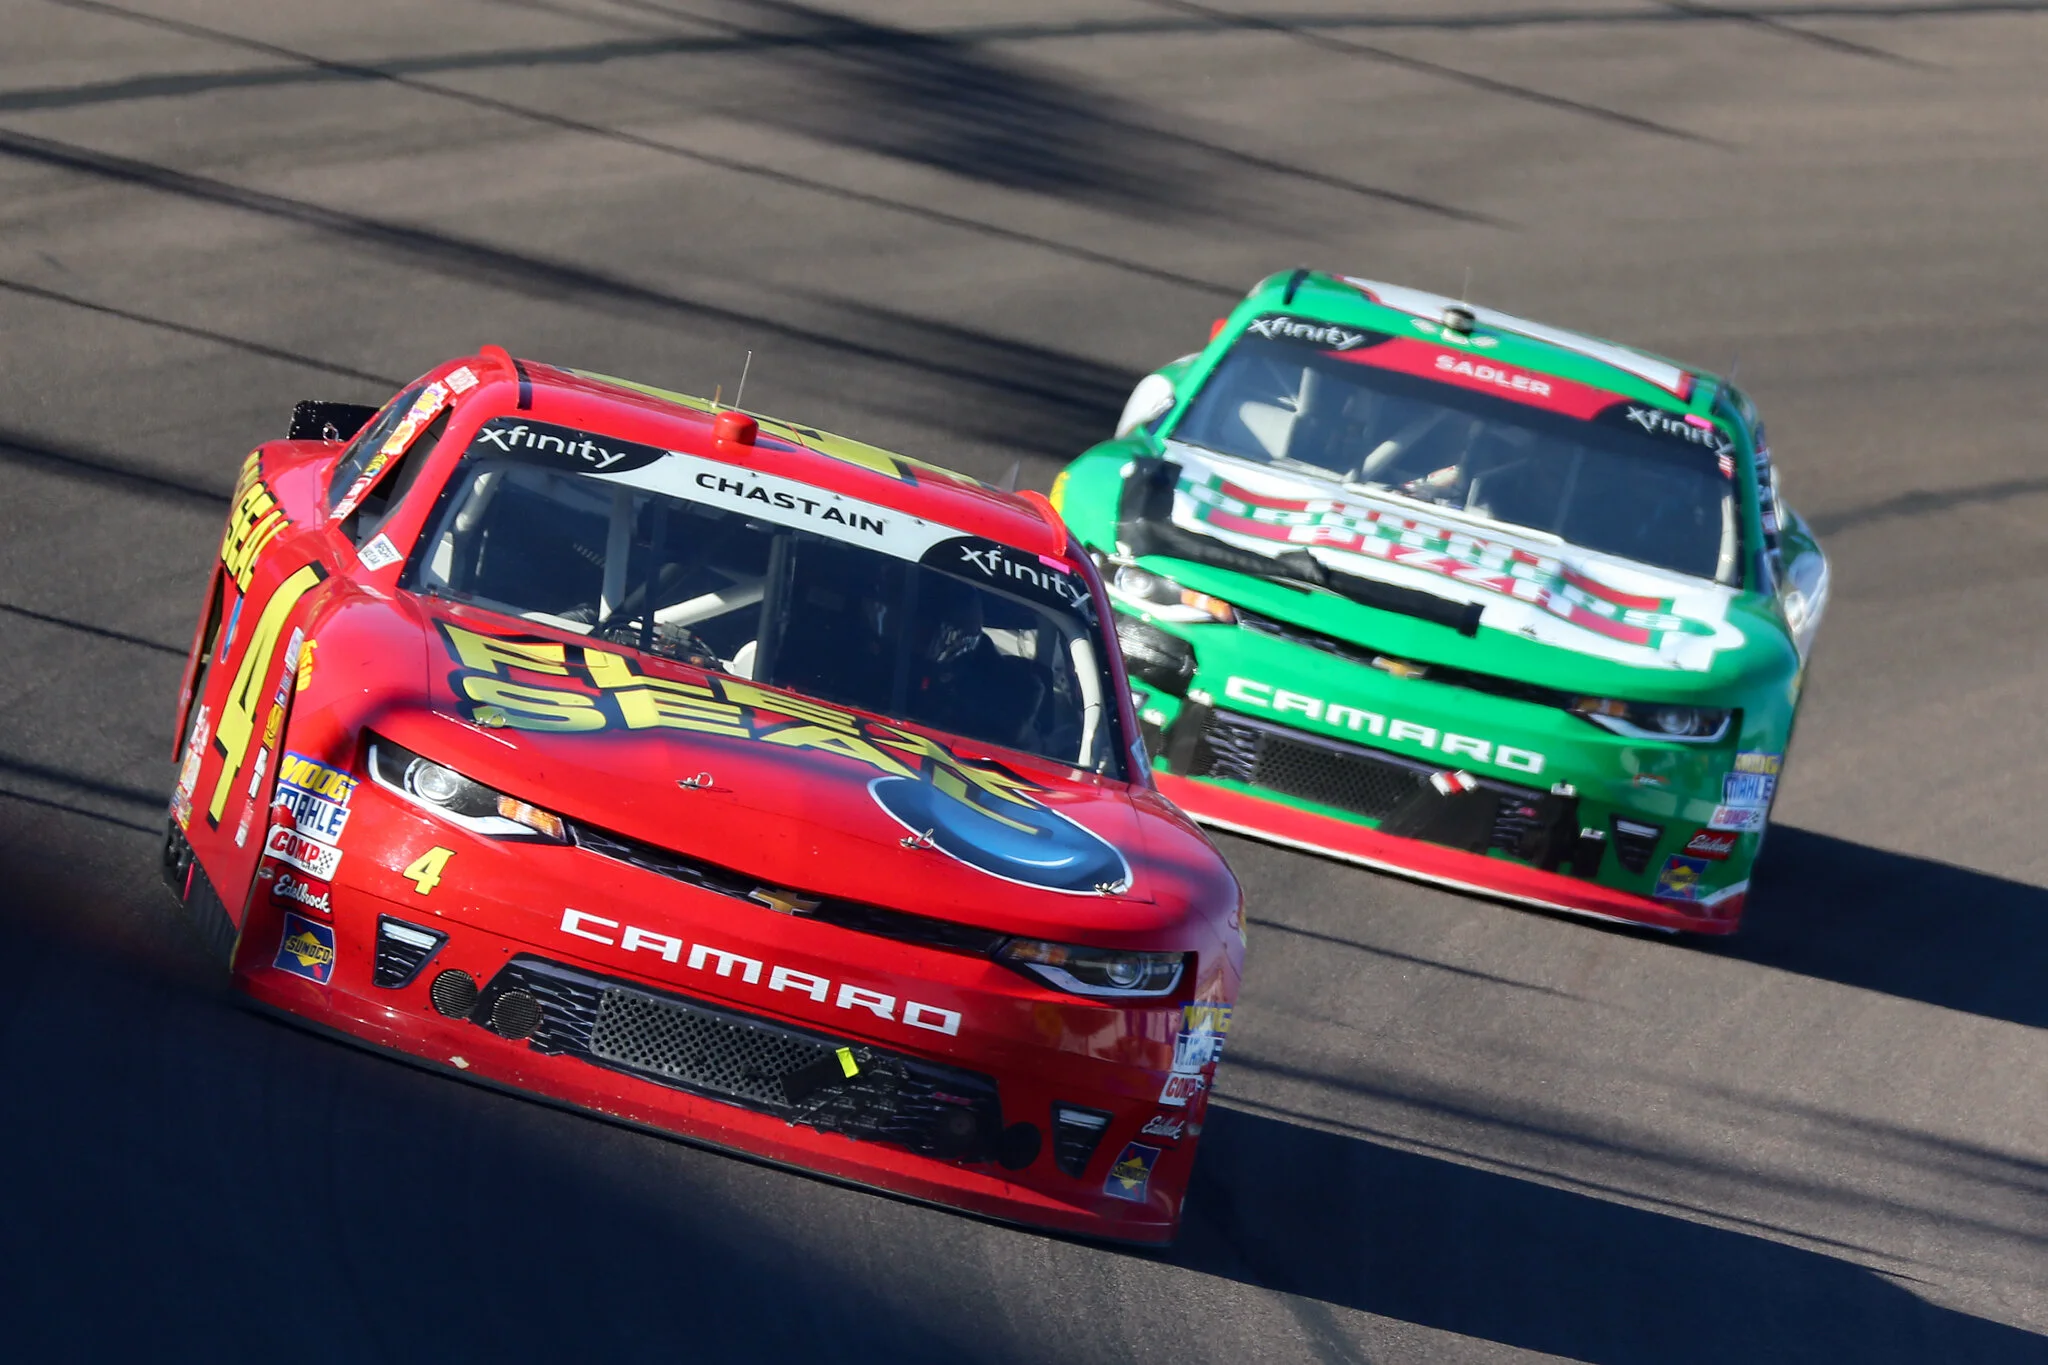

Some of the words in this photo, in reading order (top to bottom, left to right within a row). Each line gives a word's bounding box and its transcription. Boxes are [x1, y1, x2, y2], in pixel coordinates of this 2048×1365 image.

[1248, 316, 1364, 352] xfinity
[1435, 354, 1551, 397] SADLER
[477, 424, 627, 470] xfinity
[1626, 405, 1736, 457] xfinity
[695, 472, 885, 536] CHASTAIN
[960, 544, 1092, 609] xfinity
[206, 562, 327, 830] 4
[443, 622, 1050, 811] FLEX
[1224, 675, 1546, 775] CAMARO
[279, 755, 352, 803] MOOG
[461, 674, 1040, 836] SEAL
[278, 786, 347, 837] MAHLE
[270, 831, 321, 863] COMP
[402, 846, 457, 896] 4
[273, 873, 332, 914] Edelbrock
[286, 936, 332, 963] SUNOCO
[559, 907, 962, 1037] CAMARO
